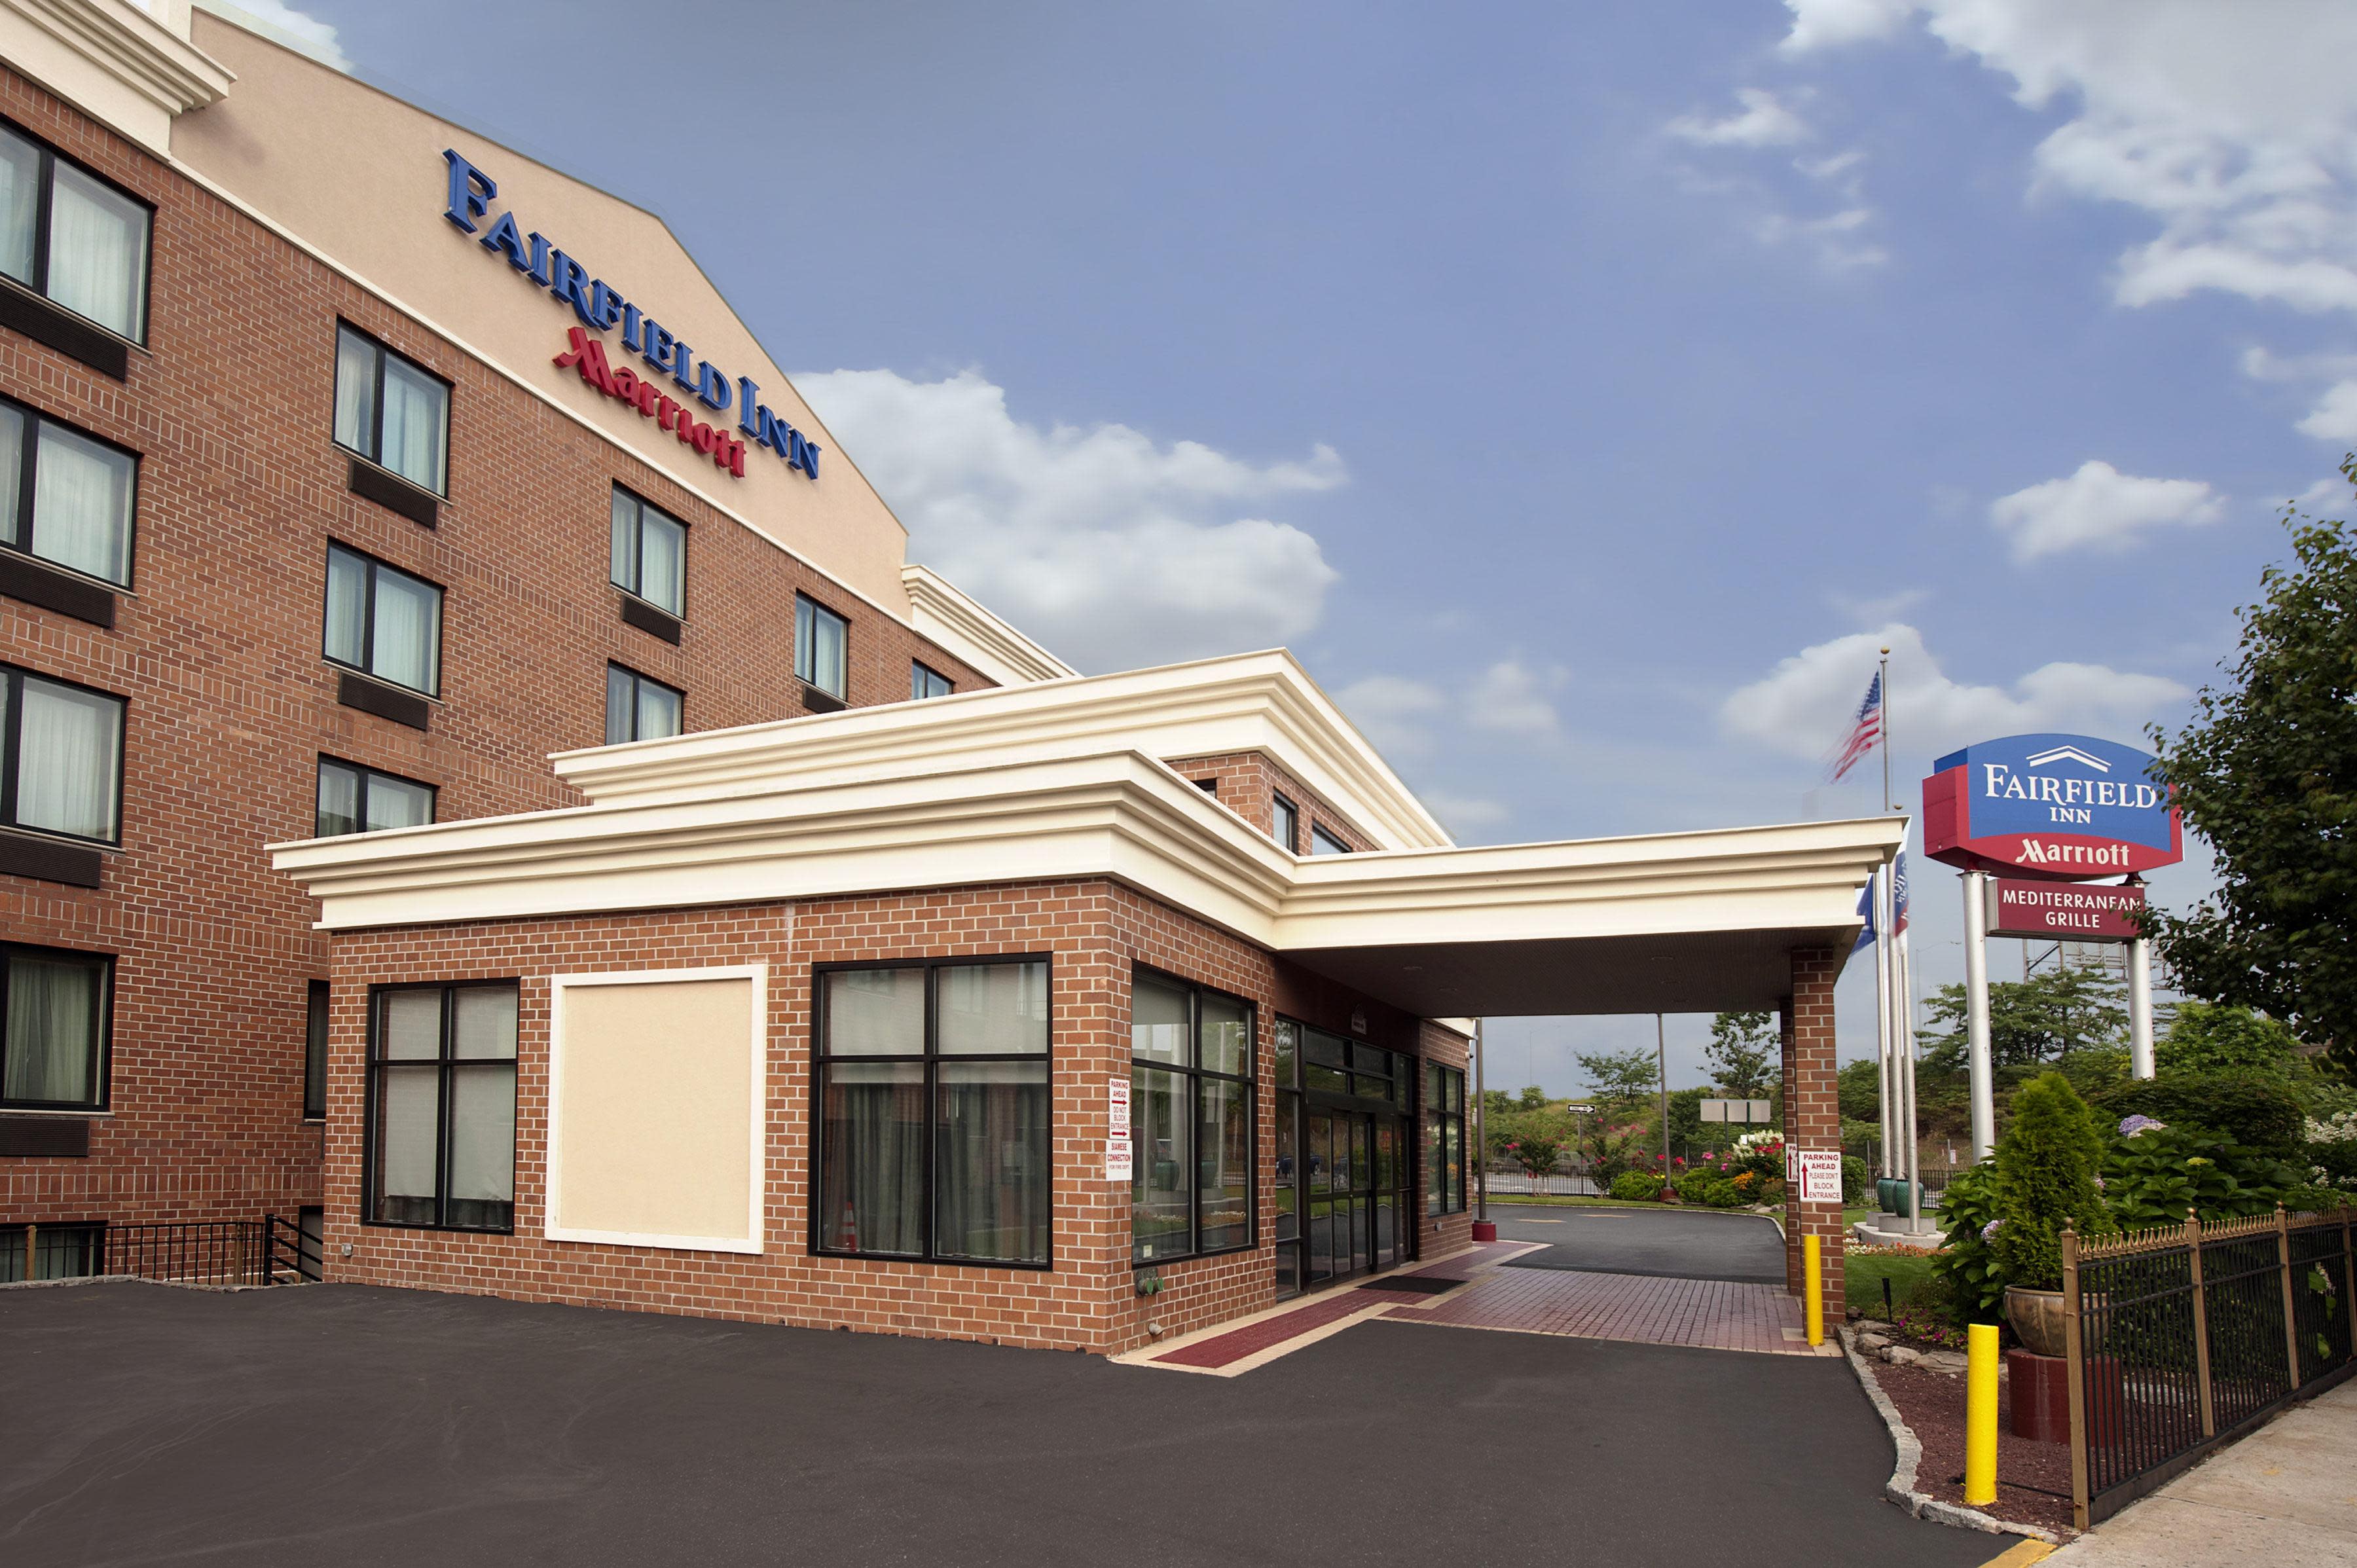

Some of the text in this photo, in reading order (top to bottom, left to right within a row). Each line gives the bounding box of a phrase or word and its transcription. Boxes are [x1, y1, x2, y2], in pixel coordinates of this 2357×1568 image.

[443, 149, 822, 480] FAIRFIELD INN
[552, 326, 747, 478] Marriott
[1982, 763, 2157, 809] FAIRFIELD
[2049, 807, 2092, 824] INN
[2015, 838, 2129, 866] Marriott
[2045, 911, 2100, 928] GRILLE
